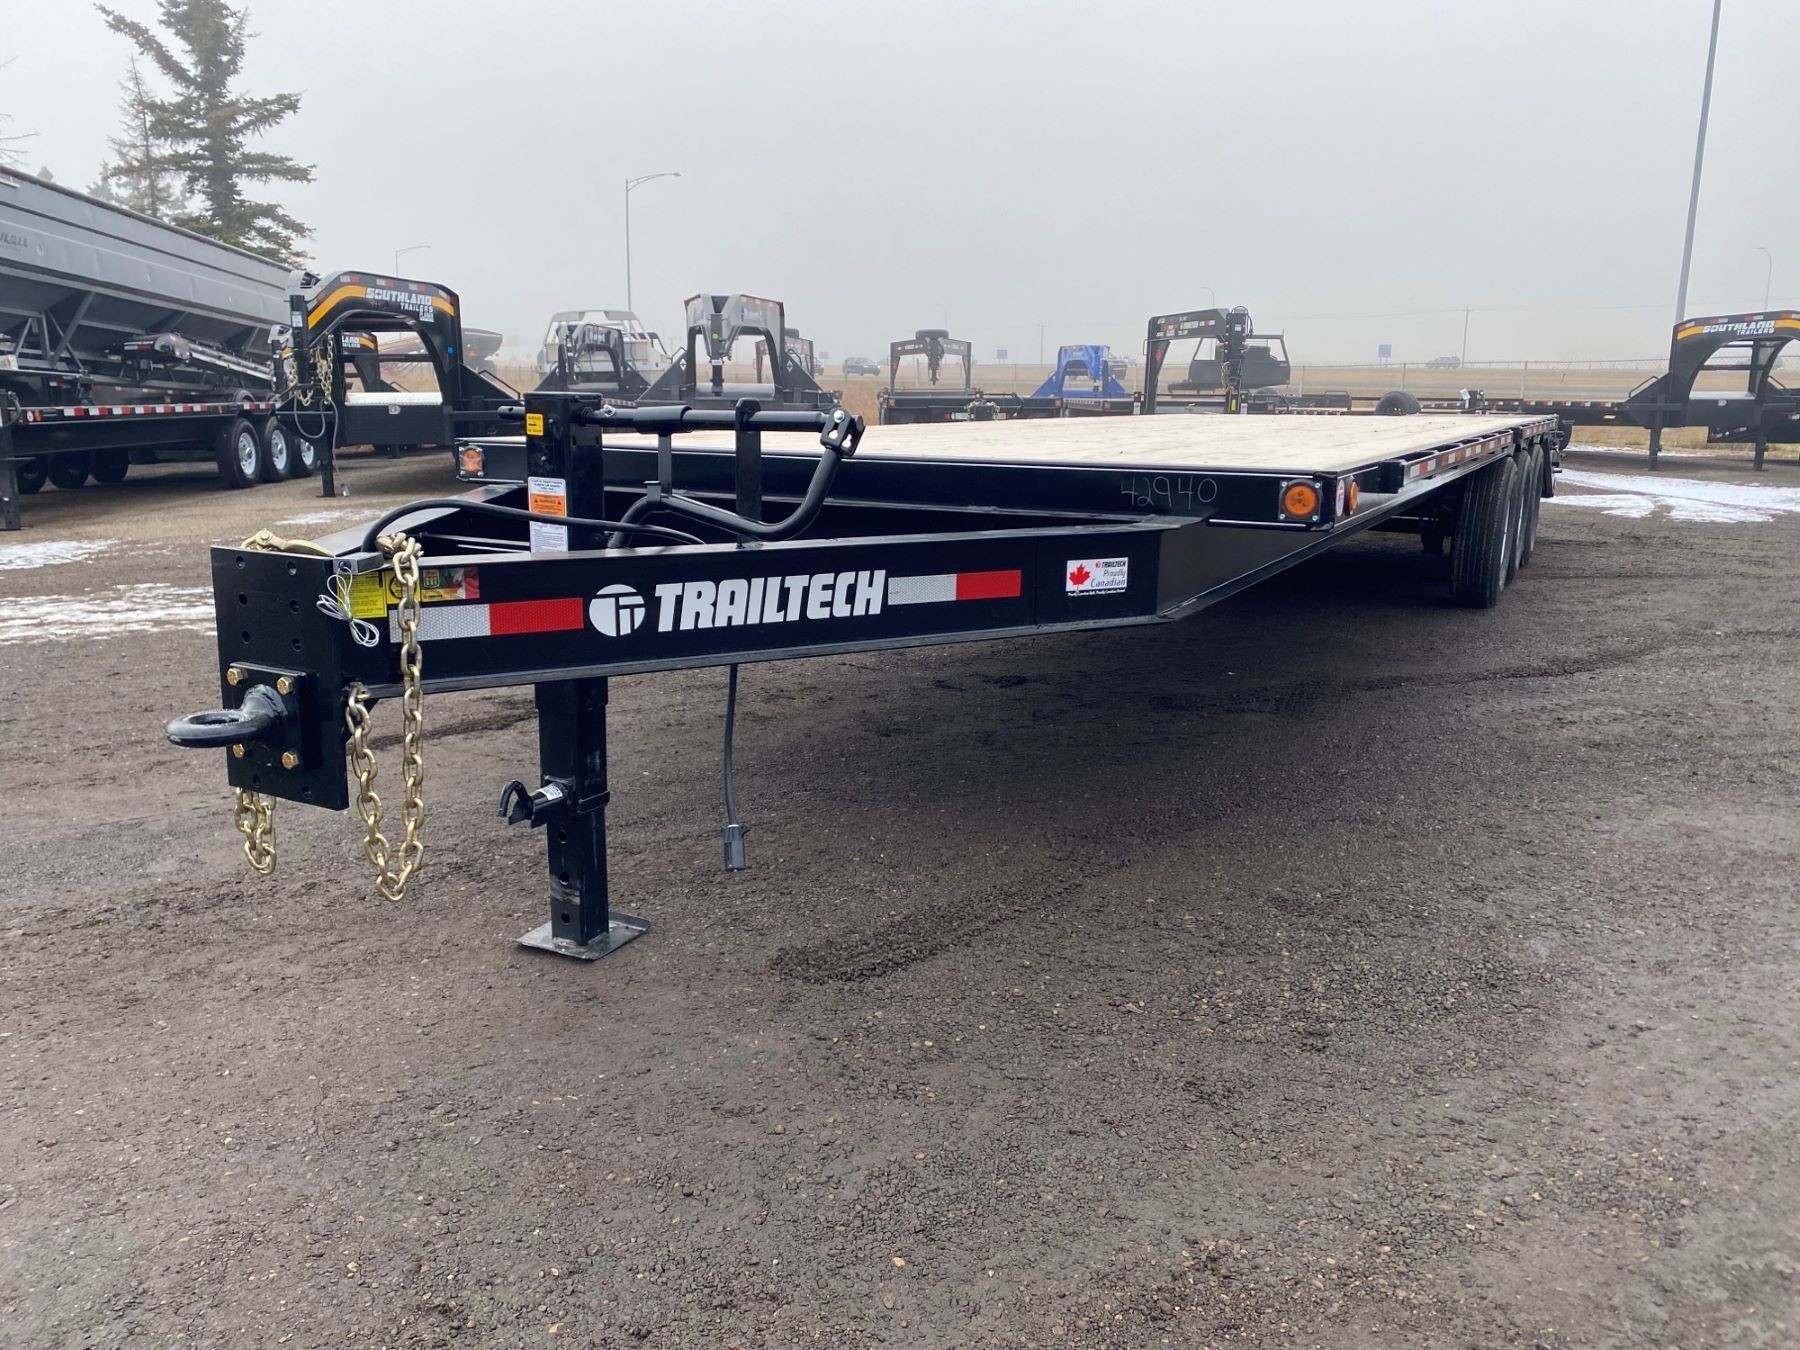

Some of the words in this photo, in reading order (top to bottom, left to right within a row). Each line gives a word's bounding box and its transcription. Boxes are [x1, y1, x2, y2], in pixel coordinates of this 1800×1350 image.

[366, 288, 432, 304] SOUTHLAND
[400, 303, 433, 312] TRAILERS
[1703, 321, 1775, 333] SOUTHLAND
[1736, 327, 1775, 336] TRAILERS
[1121, 476, 1217, 509] 42940
[1101, 560, 1127, 569] TRAILTECH
[1103, 569, 1126, 578] Proudly
[1090, 578, 1126, 588] Canadian
[655, 569, 887, 632] TRAILTECH
